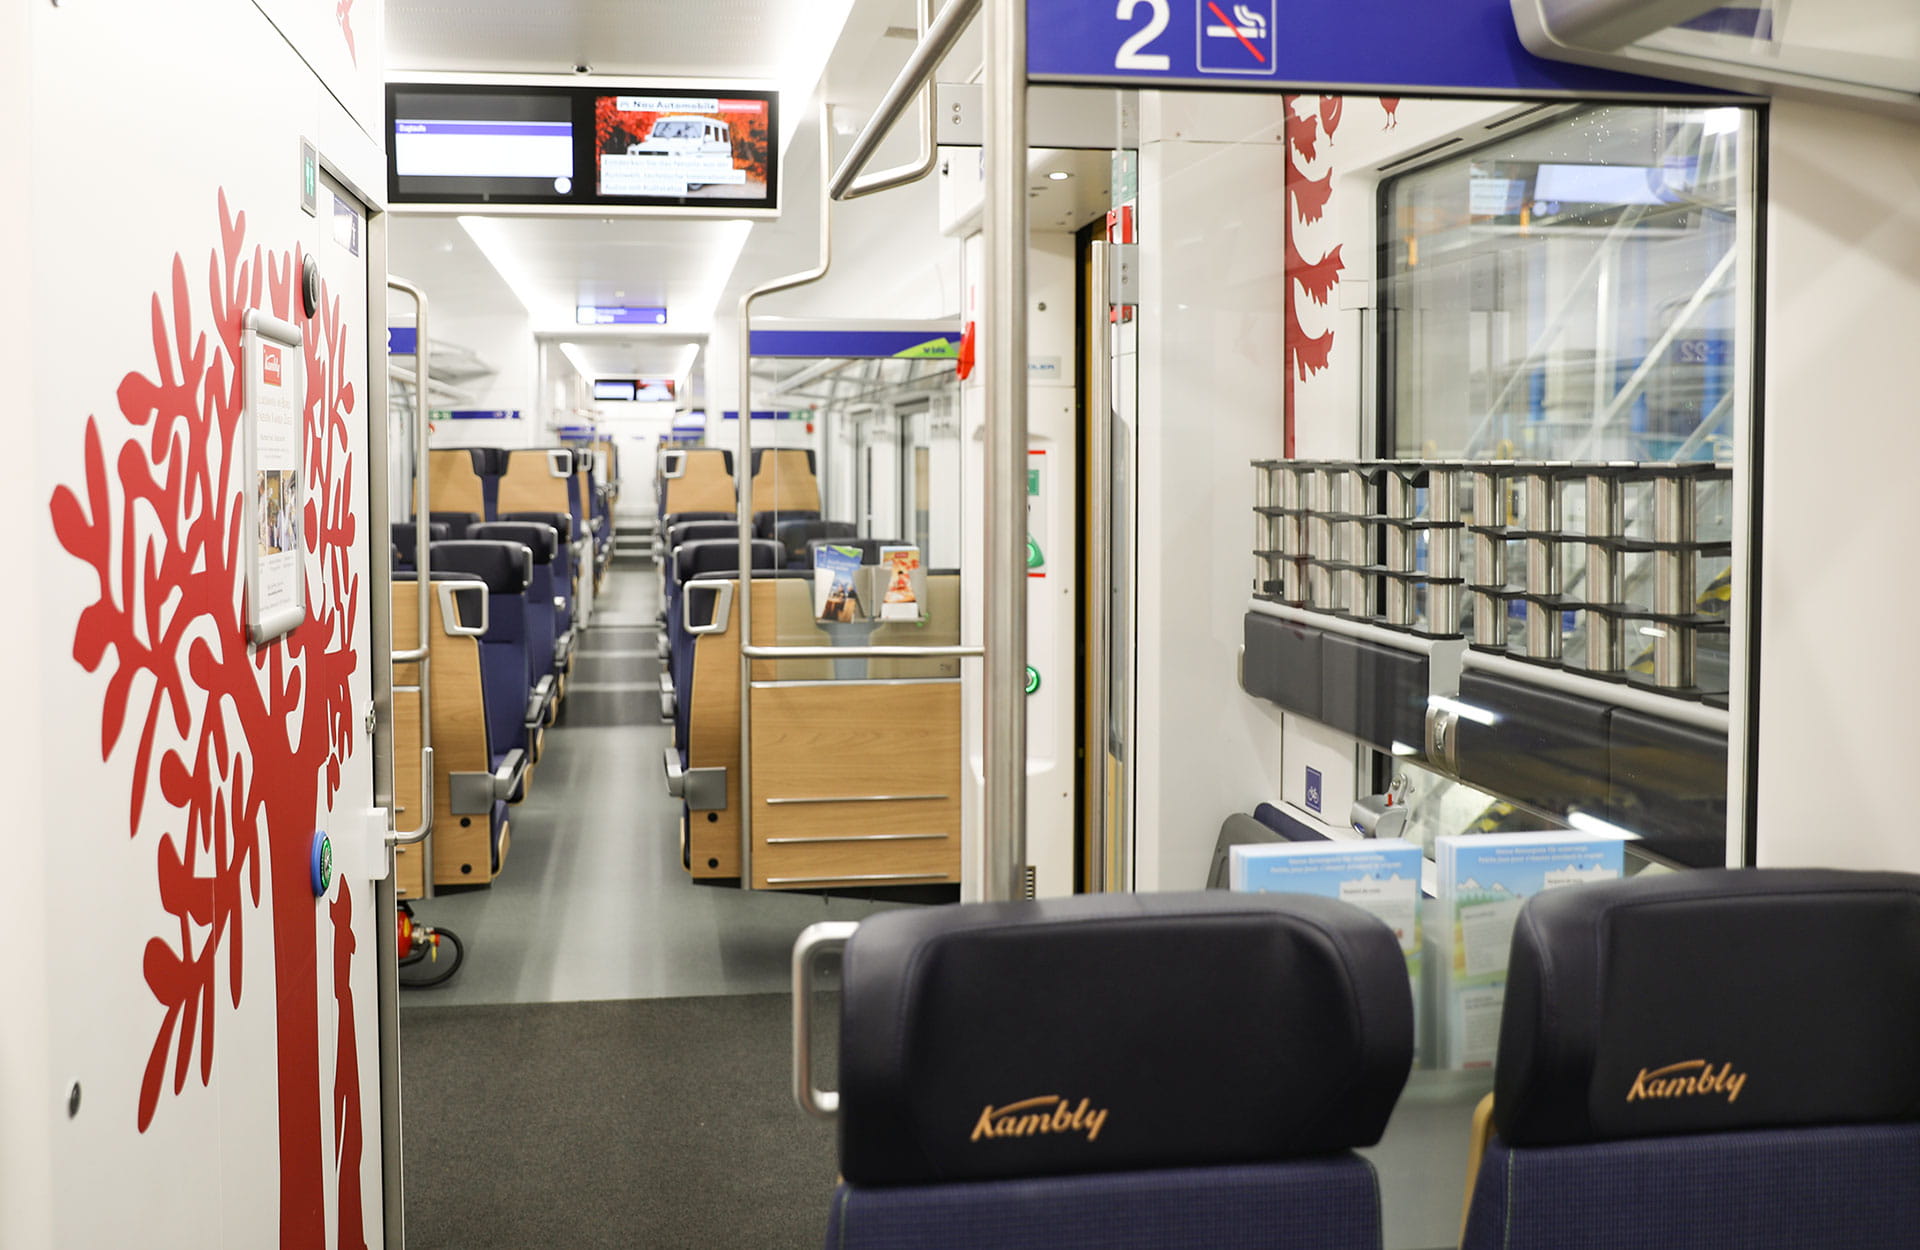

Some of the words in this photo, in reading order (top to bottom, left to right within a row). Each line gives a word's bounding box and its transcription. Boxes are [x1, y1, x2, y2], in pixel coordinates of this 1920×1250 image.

[1115, 0, 1170, 70] 2
[1626, 1059, 1748, 1104] Kambly
[969, 1095, 1109, 1142] Kambly
